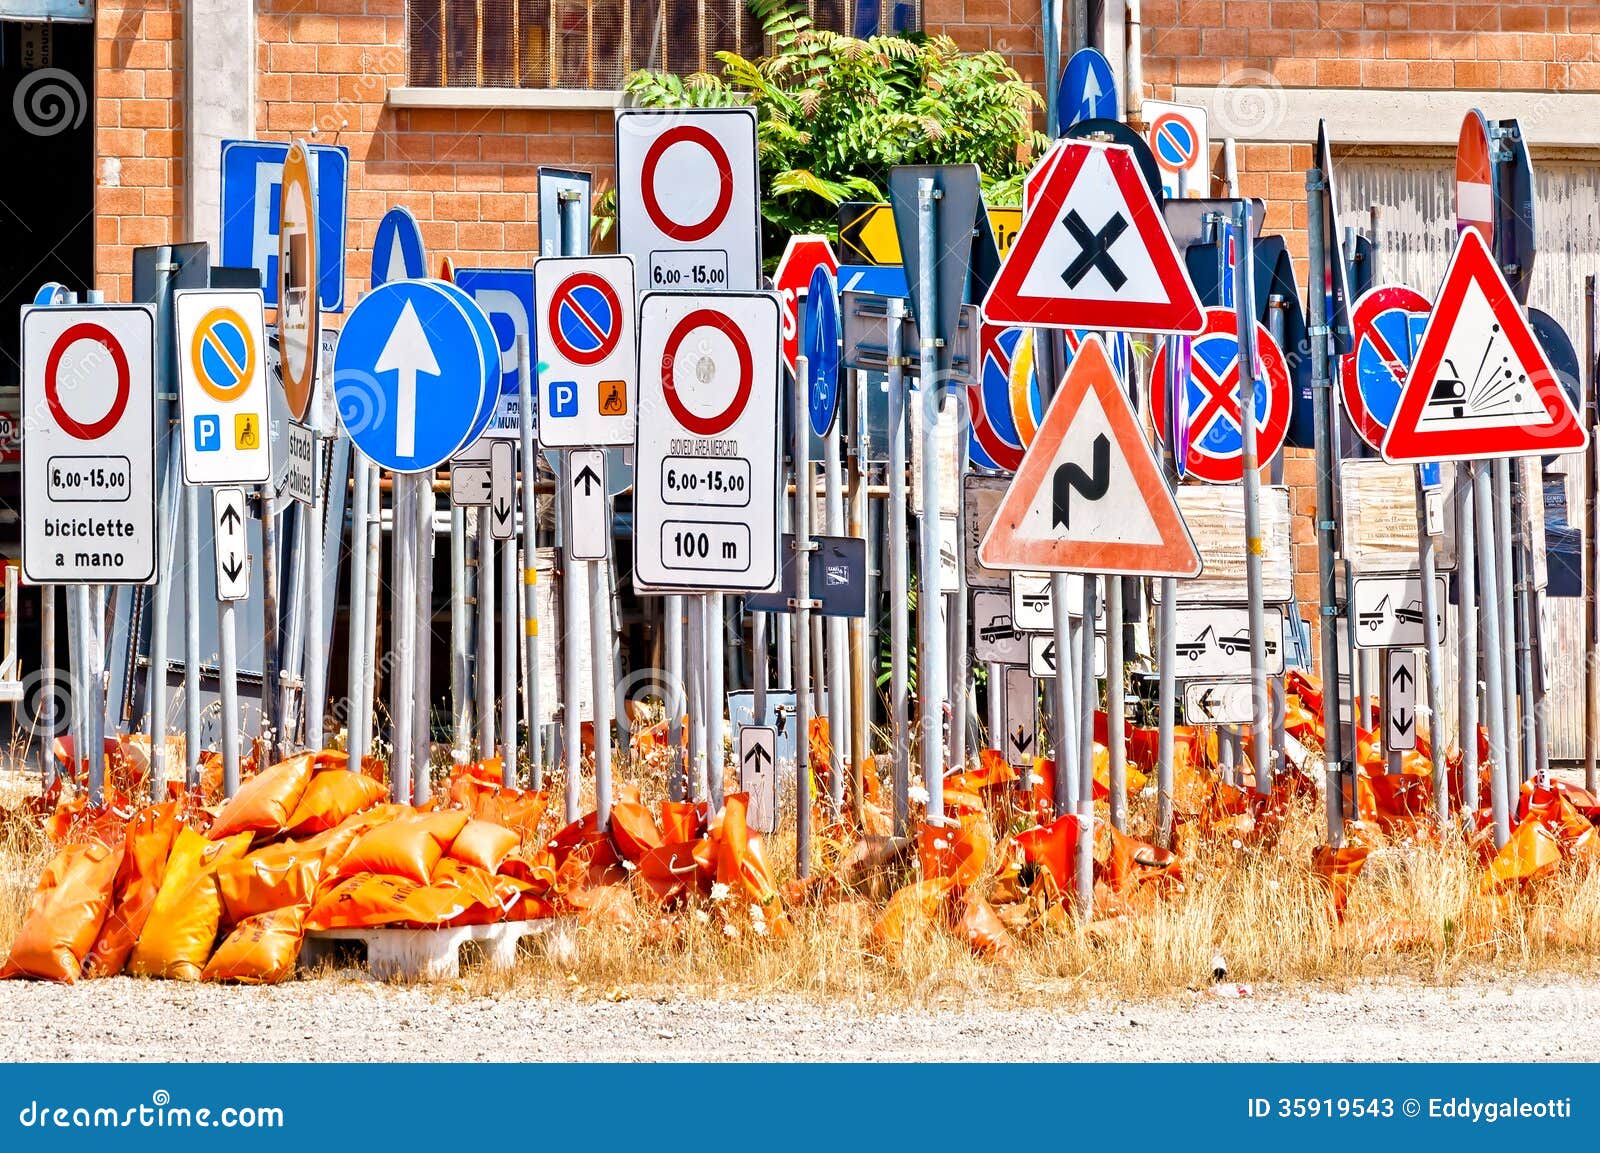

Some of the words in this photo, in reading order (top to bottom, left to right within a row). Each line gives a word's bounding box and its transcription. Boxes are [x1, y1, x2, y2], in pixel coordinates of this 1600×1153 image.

[556, 386, 573, 413] P
[200, 419, 215, 447] P
[289, 431, 311, 461] strada
[710, 439, 738, 457] MERCATO
[289, 464, 311, 496] chiusa
[44, 518, 135, 537] biciclette
[674, 532, 709, 558] 100
[722, 542, 737, 559] m
[55, 552, 65, 567] a
[75, 552, 124, 567] mano
